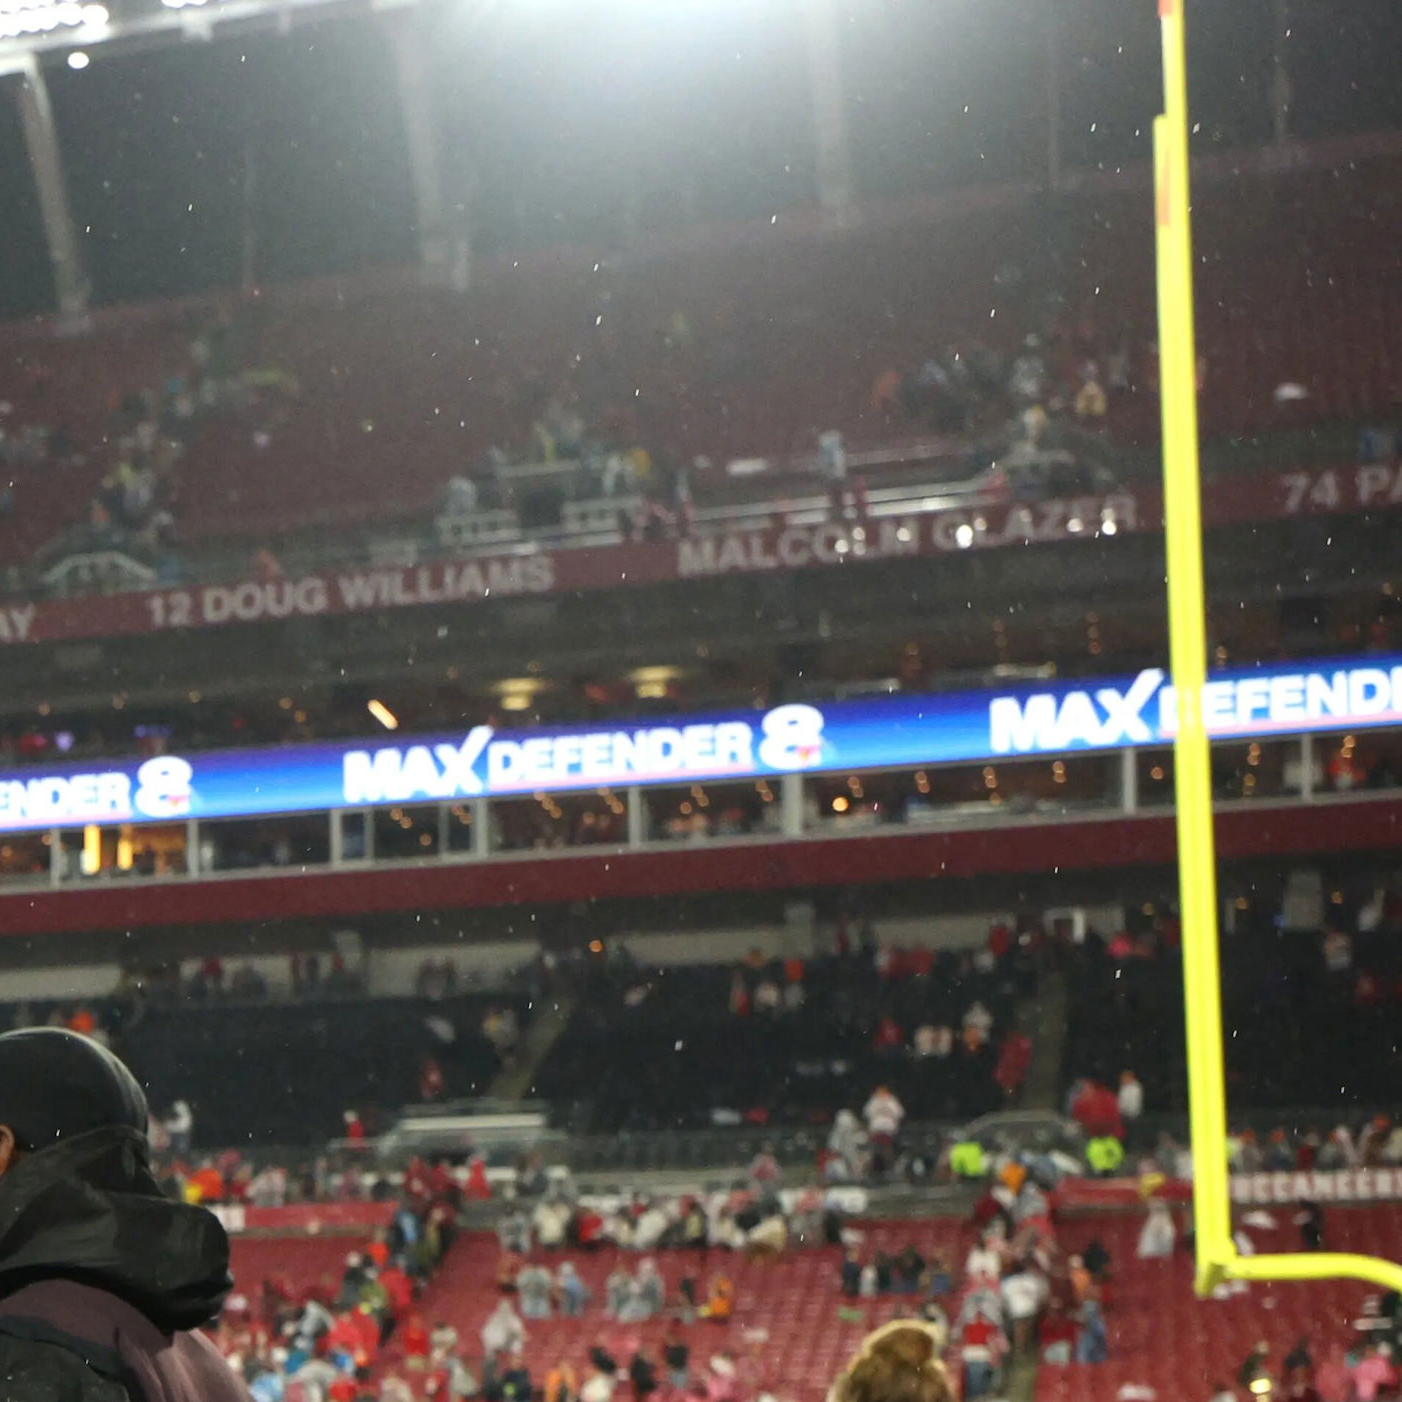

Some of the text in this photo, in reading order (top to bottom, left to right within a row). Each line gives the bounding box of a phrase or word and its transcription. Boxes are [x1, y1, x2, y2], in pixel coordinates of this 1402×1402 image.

[147, 555, 555, 629] 12 DOUG WILLIAMS
[990, 666, 1402, 754] MAX EFEND
[342, 724, 494, 802] MAX
[487, 719, 753, 784] DEFENDER
[1232, 1167, 1402, 1204] UCCANEER
